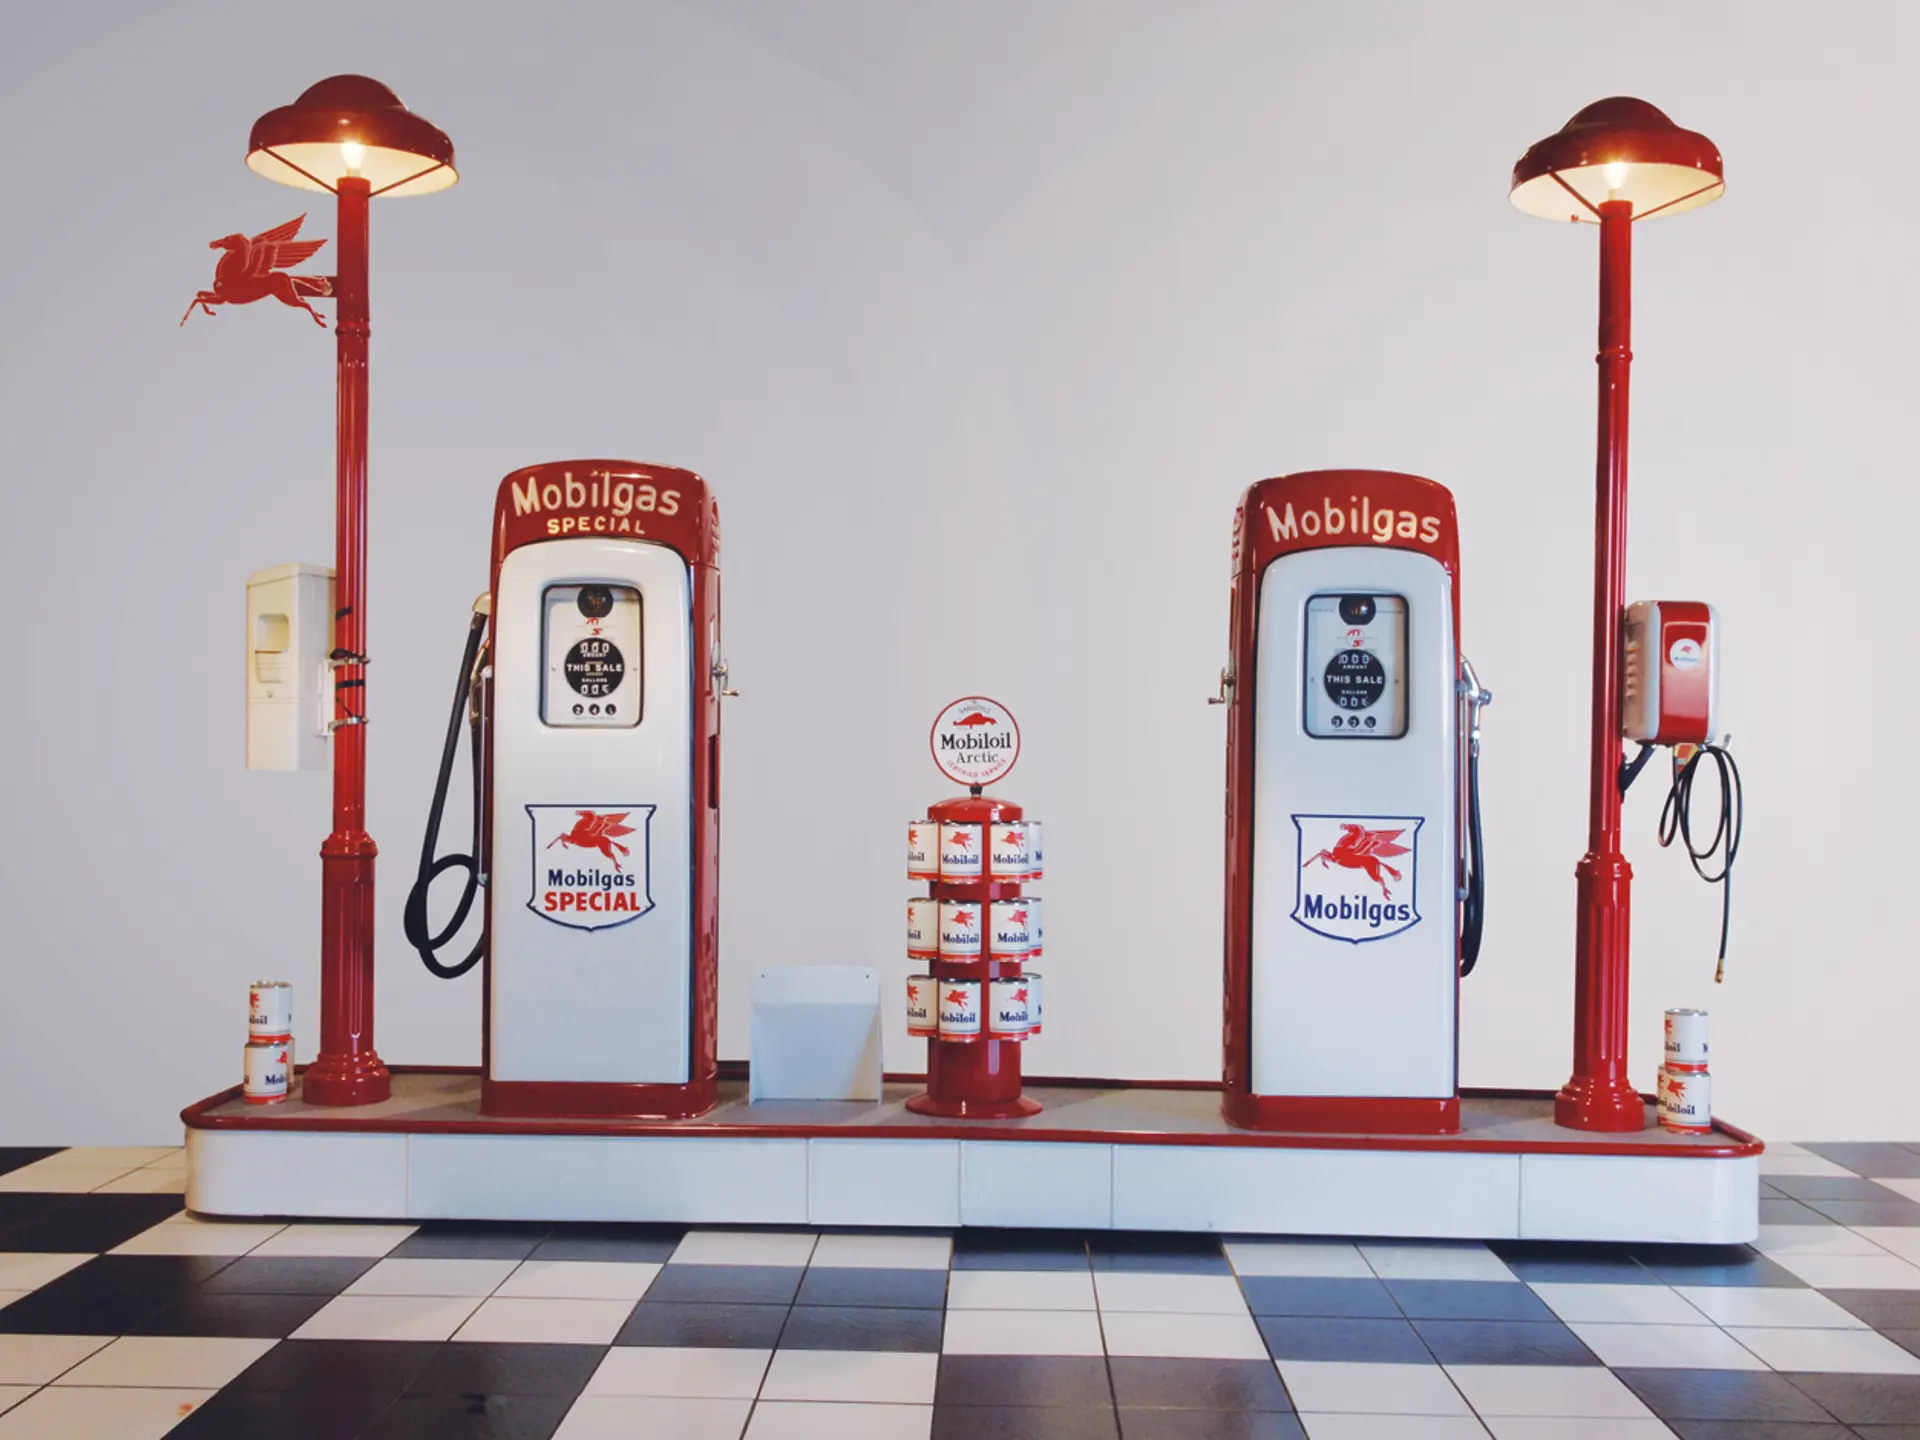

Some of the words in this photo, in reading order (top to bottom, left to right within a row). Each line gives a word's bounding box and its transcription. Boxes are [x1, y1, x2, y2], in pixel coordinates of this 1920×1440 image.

[511, 471, 682, 517] Mobilgas
[547, 516, 645, 534] SPECIAL
[1266, 495, 1441, 543] Mobilgas
[566, 664, 591, 672] THIS
[595, 664, 623, 672] SALE
[1326, 675, 1351, 684] THIS
[1355, 675, 1383, 684] SALE
[940, 732, 1012, 750] Mobiloil
[956, 751, 999, 764] Arctic
[942, 854, 979, 864] Mobiloil
[547, 869, 636, 891] Mobilgas
[544, 891, 641, 912] SPECIAL
[1303, 894, 1411, 928] Mobilgas
[942, 933, 979, 943] Mobiloil
[265, 1074, 286, 1086] Mob
